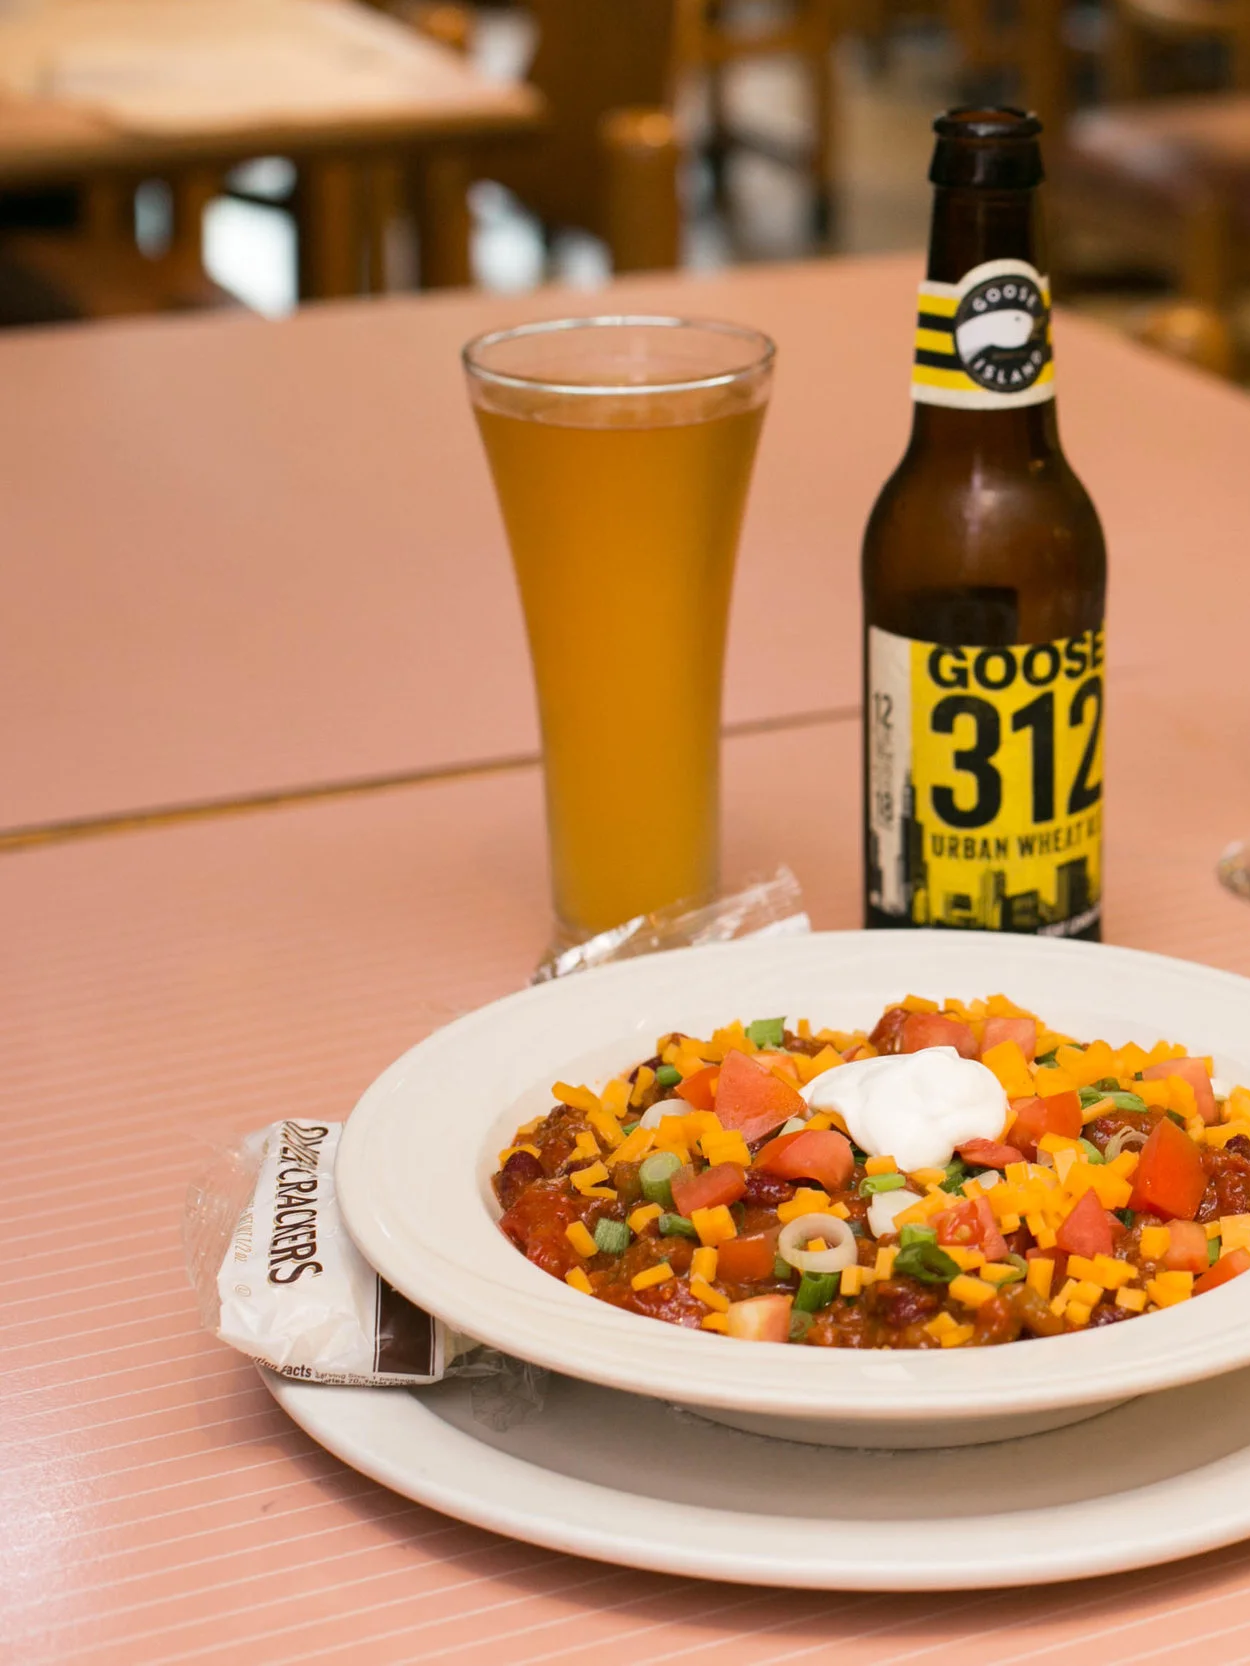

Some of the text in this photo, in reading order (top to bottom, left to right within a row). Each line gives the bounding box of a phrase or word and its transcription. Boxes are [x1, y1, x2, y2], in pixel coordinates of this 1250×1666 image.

[972, 284, 1038, 312] GOOSE
[973, 350, 1042, 384] ISLAND
[928, 630, 1103, 690] GOOSE
[930, 676, 1103, 829] 312
[931, 833, 1009, 861] URBAN
[1017, 821, 1082, 858] WHEAT
[268, 1168, 323, 1285] CRACKERS
